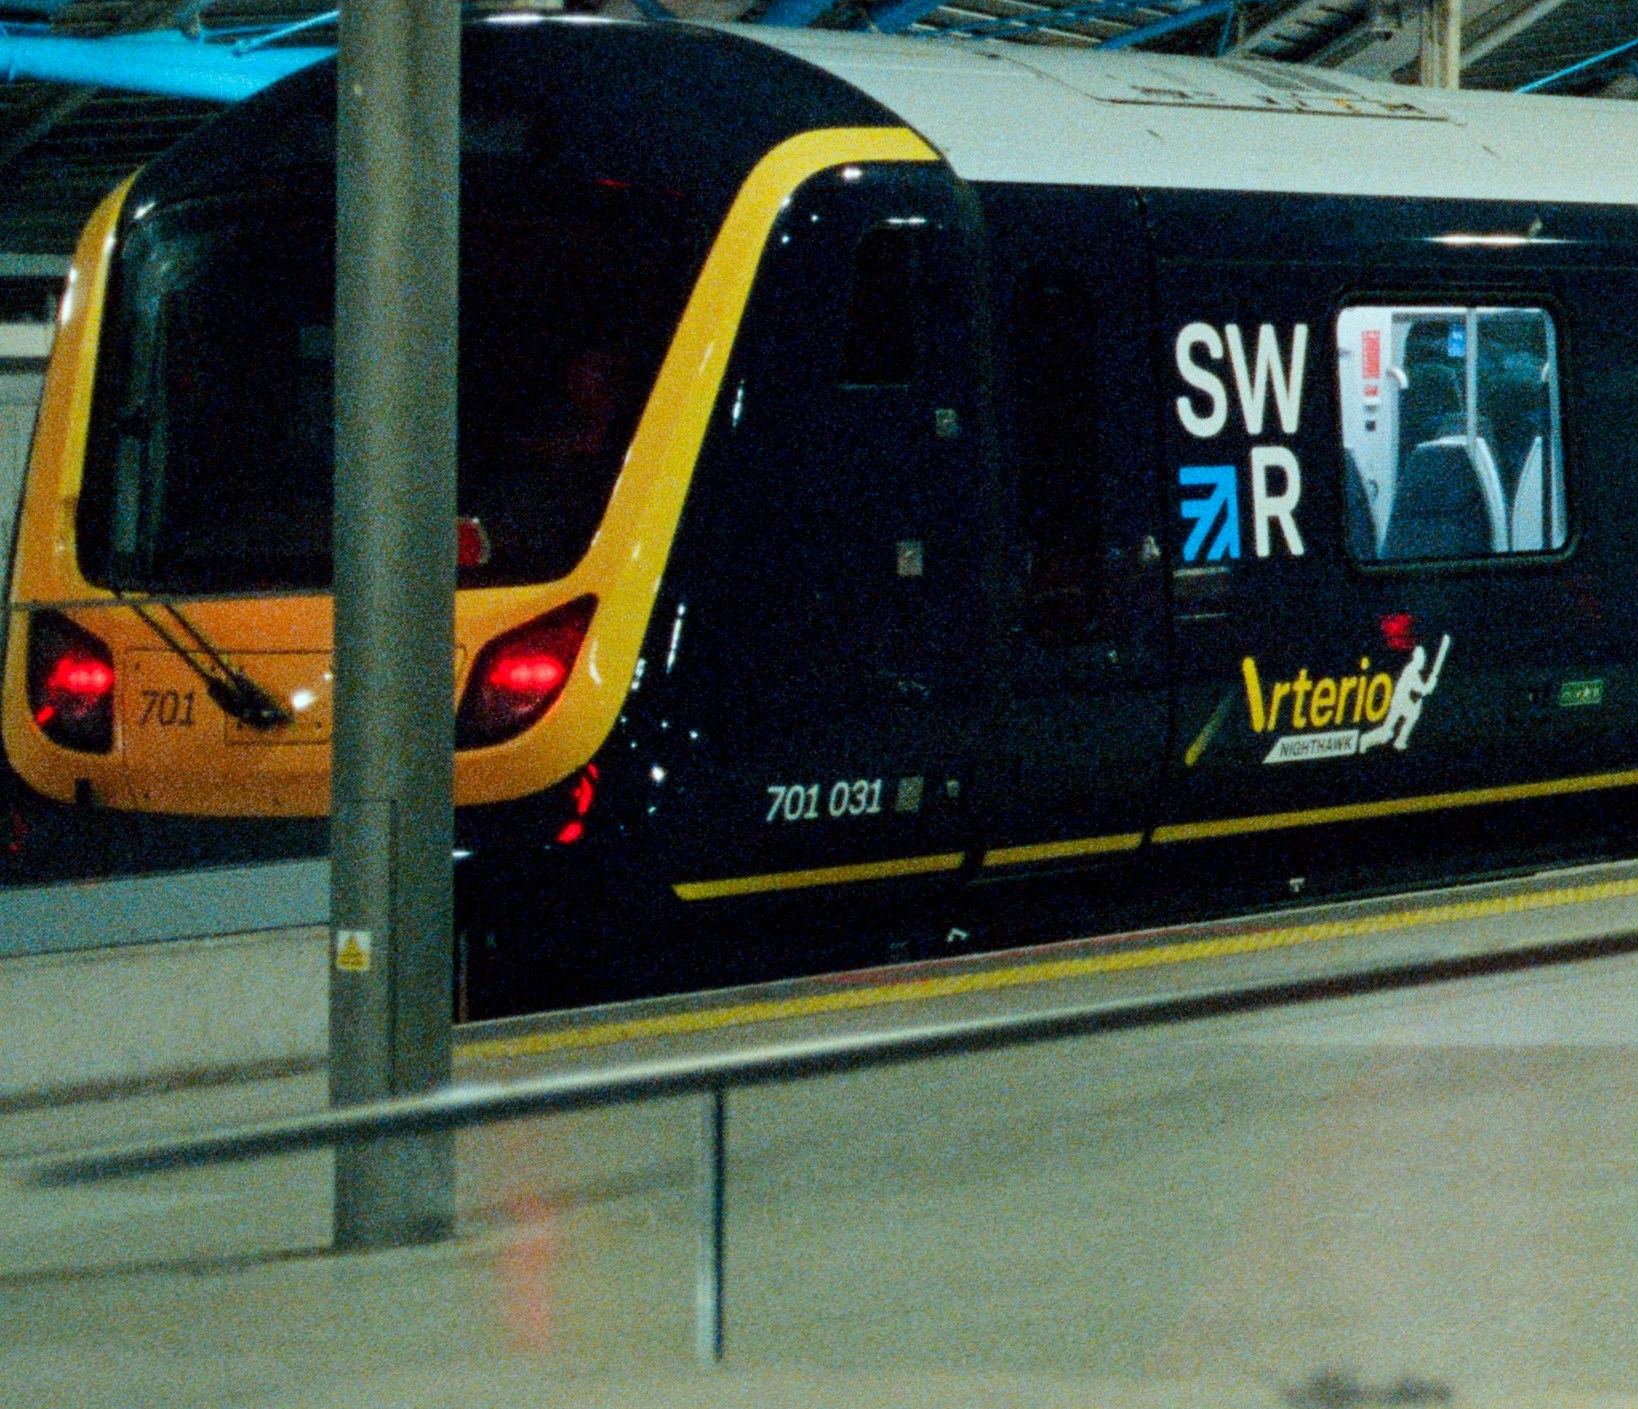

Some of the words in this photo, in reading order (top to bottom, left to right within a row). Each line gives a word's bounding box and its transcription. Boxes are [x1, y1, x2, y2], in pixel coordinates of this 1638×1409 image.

[1175, 321, 1309, 438] SW
[1251, 445, 1305, 558] R
[140, 690, 193, 727] 701
[1279, 735, 1352, 758] NIGHTHAWK
[766, 783, 819, 822] 701
[829, 778, 883, 818] 031
